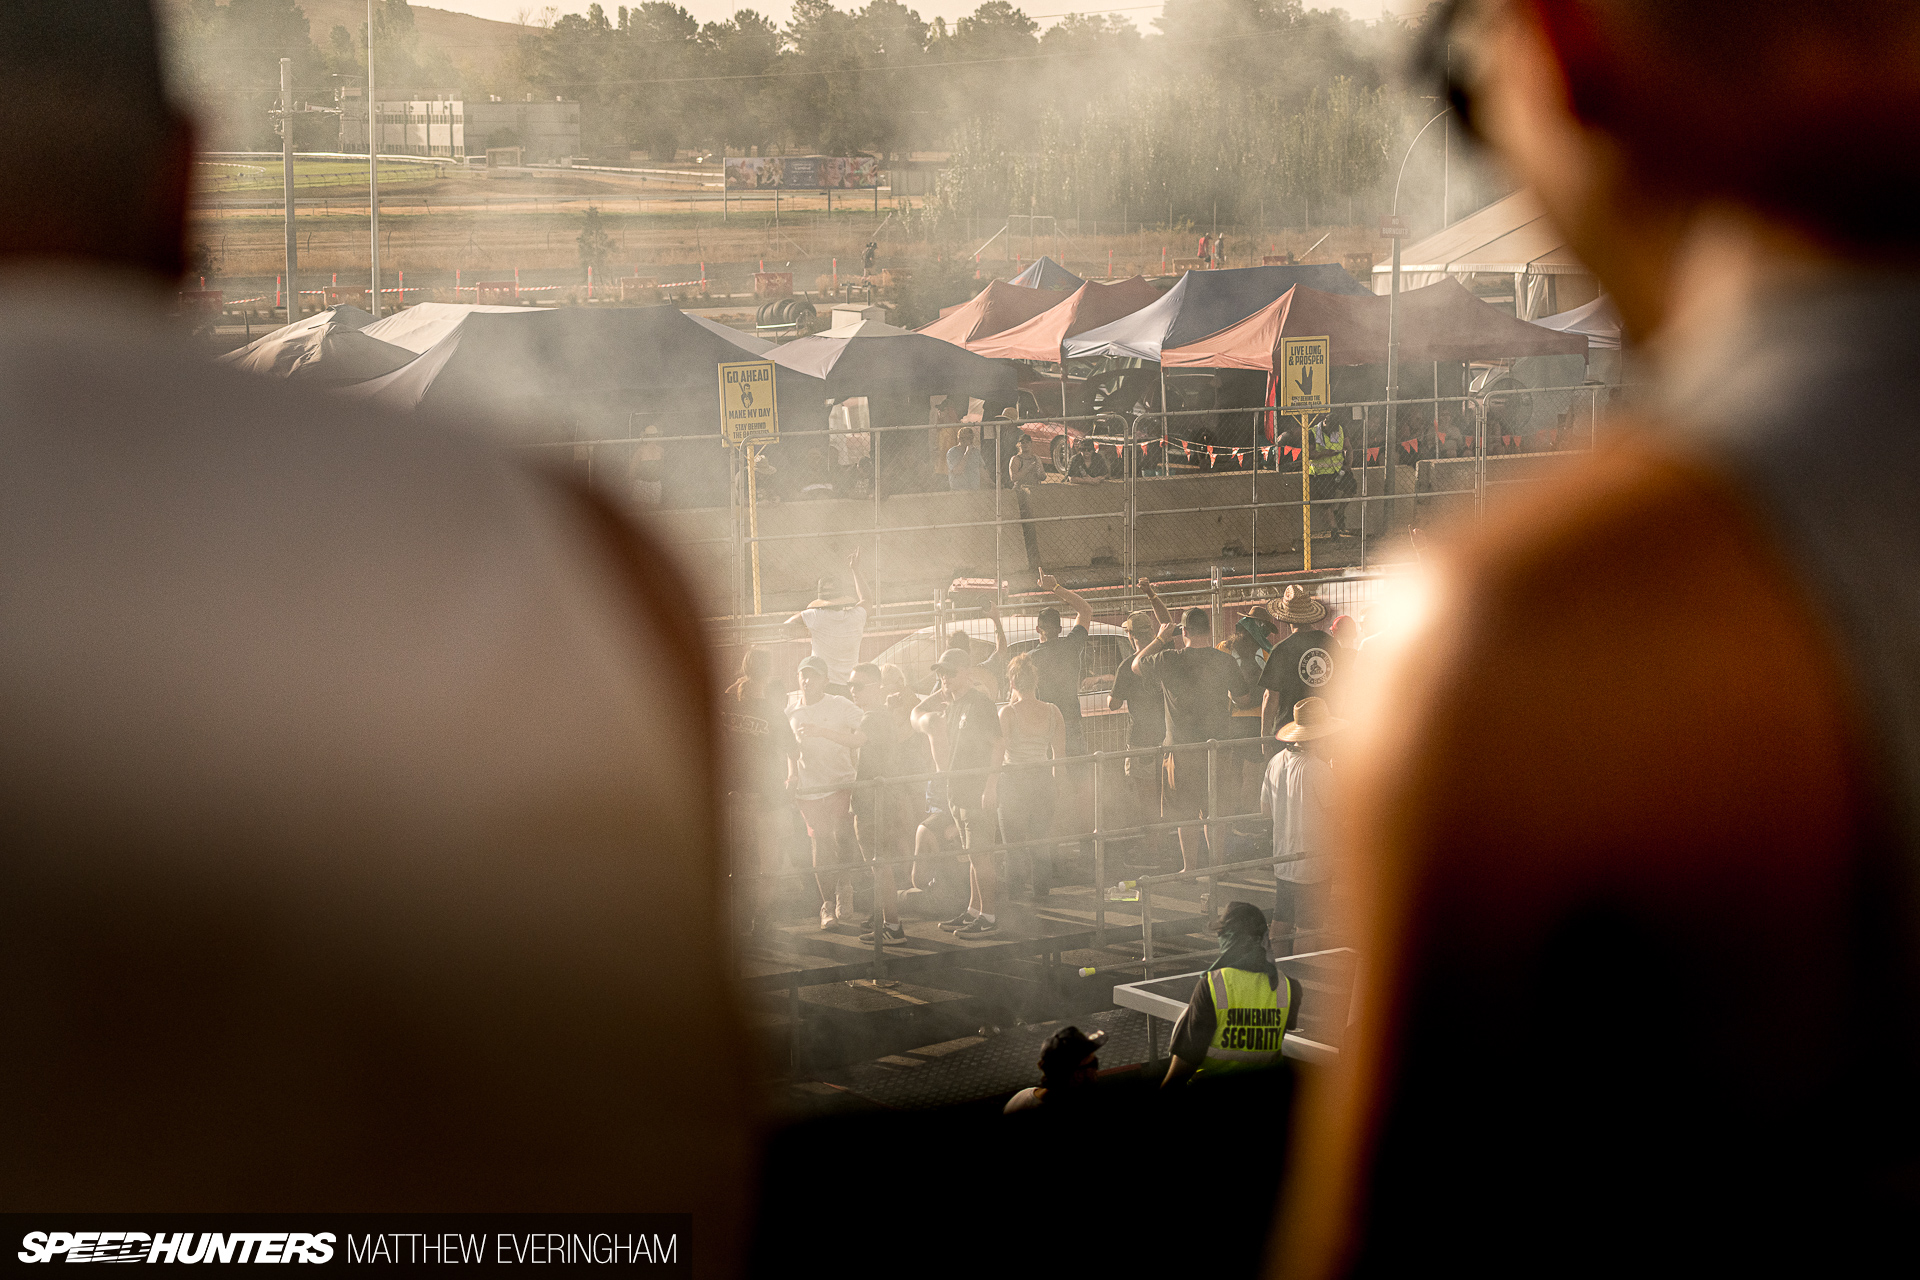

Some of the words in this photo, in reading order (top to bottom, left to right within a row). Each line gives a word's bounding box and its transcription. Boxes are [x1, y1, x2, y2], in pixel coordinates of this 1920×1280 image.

[1291, 345, 1304, 356] LIVE
[1305, 345, 1321, 355] LONG
[1289, 356, 1294, 366] &
[1295, 355, 1324, 365] PROSPER
[726, 371, 739, 383] GO
[740, 369, 769, 383] AHEAD
[729, 410, 746, 419] MAKE
[747, 408, 757, 418] MY
[758, 407, 771, 418] DAY
[735, 423, 748, 431] STAY
[748, 422, 766, 431] BEHIND
[733, 431, 742, 439] THE
[1227, 1008, 1281, 1027] SUMMERNATS
[1221, 1027, 1281, 1050] SECURITY
